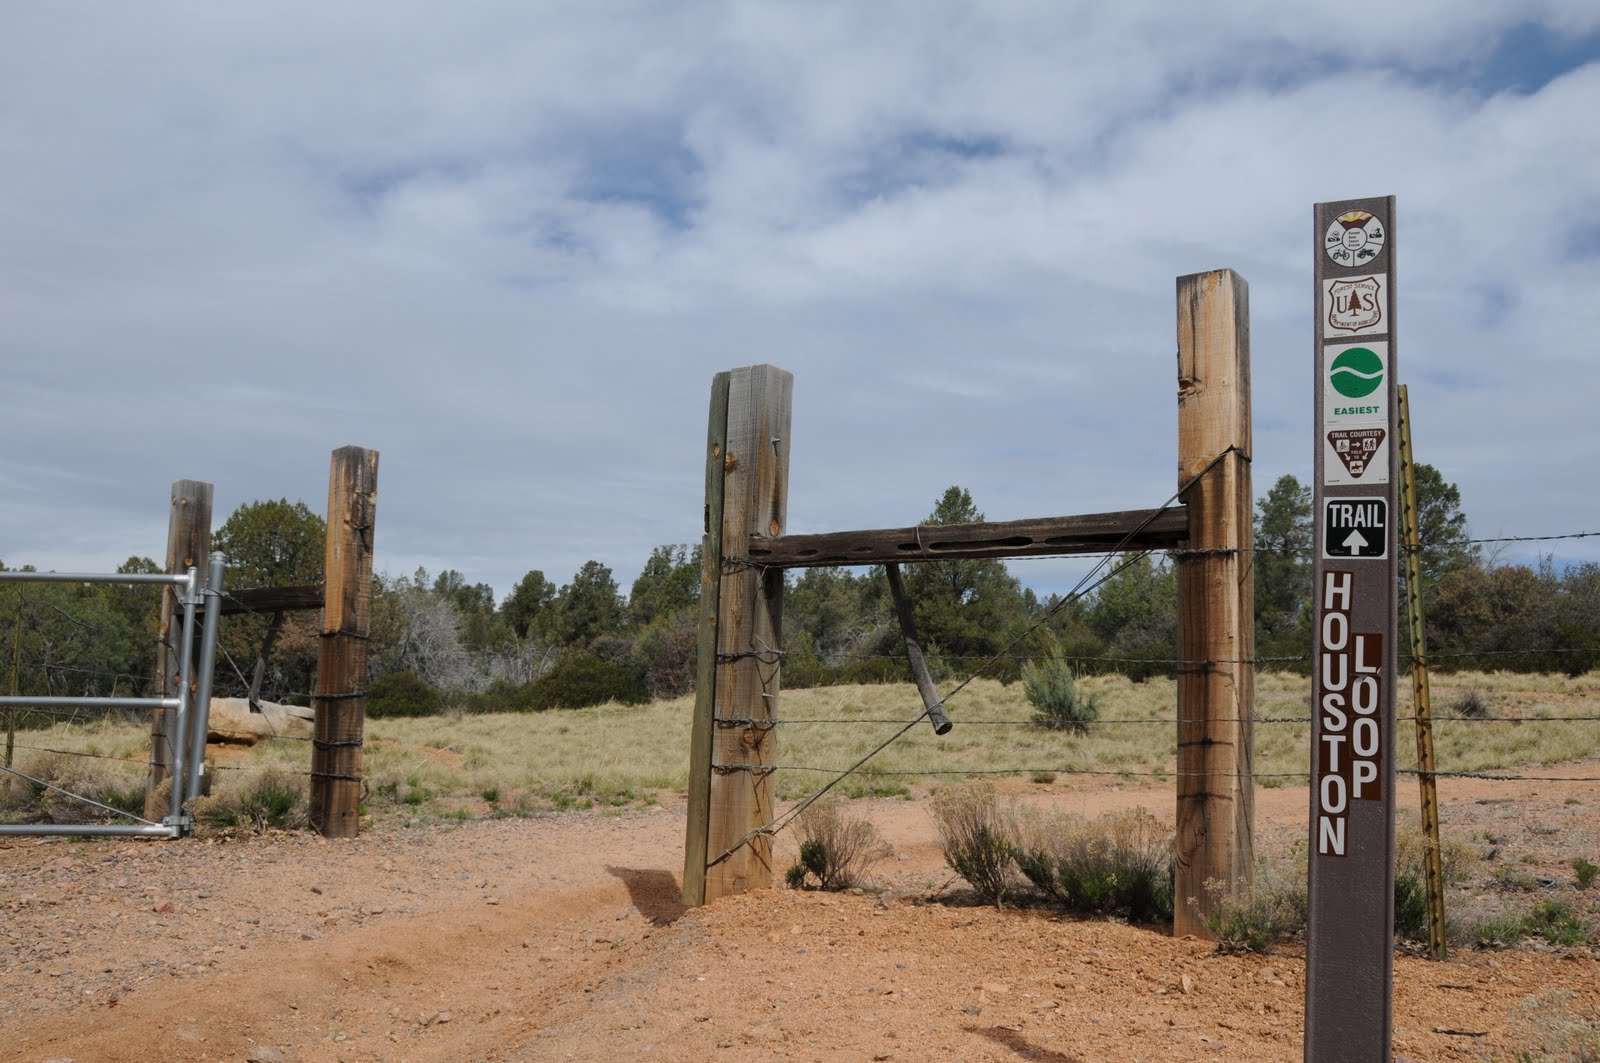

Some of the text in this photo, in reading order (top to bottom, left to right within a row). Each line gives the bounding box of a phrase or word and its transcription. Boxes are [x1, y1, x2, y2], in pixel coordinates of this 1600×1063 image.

[1334, 406, 1380, 416] EASIEST
[1349, 430, 1382, 438] COURTESY
[1329, 504, 1384, 528] TRAIL
[1319, 572, 1352, 856] HOUSTON
[1351, 635, 1380, 799] LOOP
